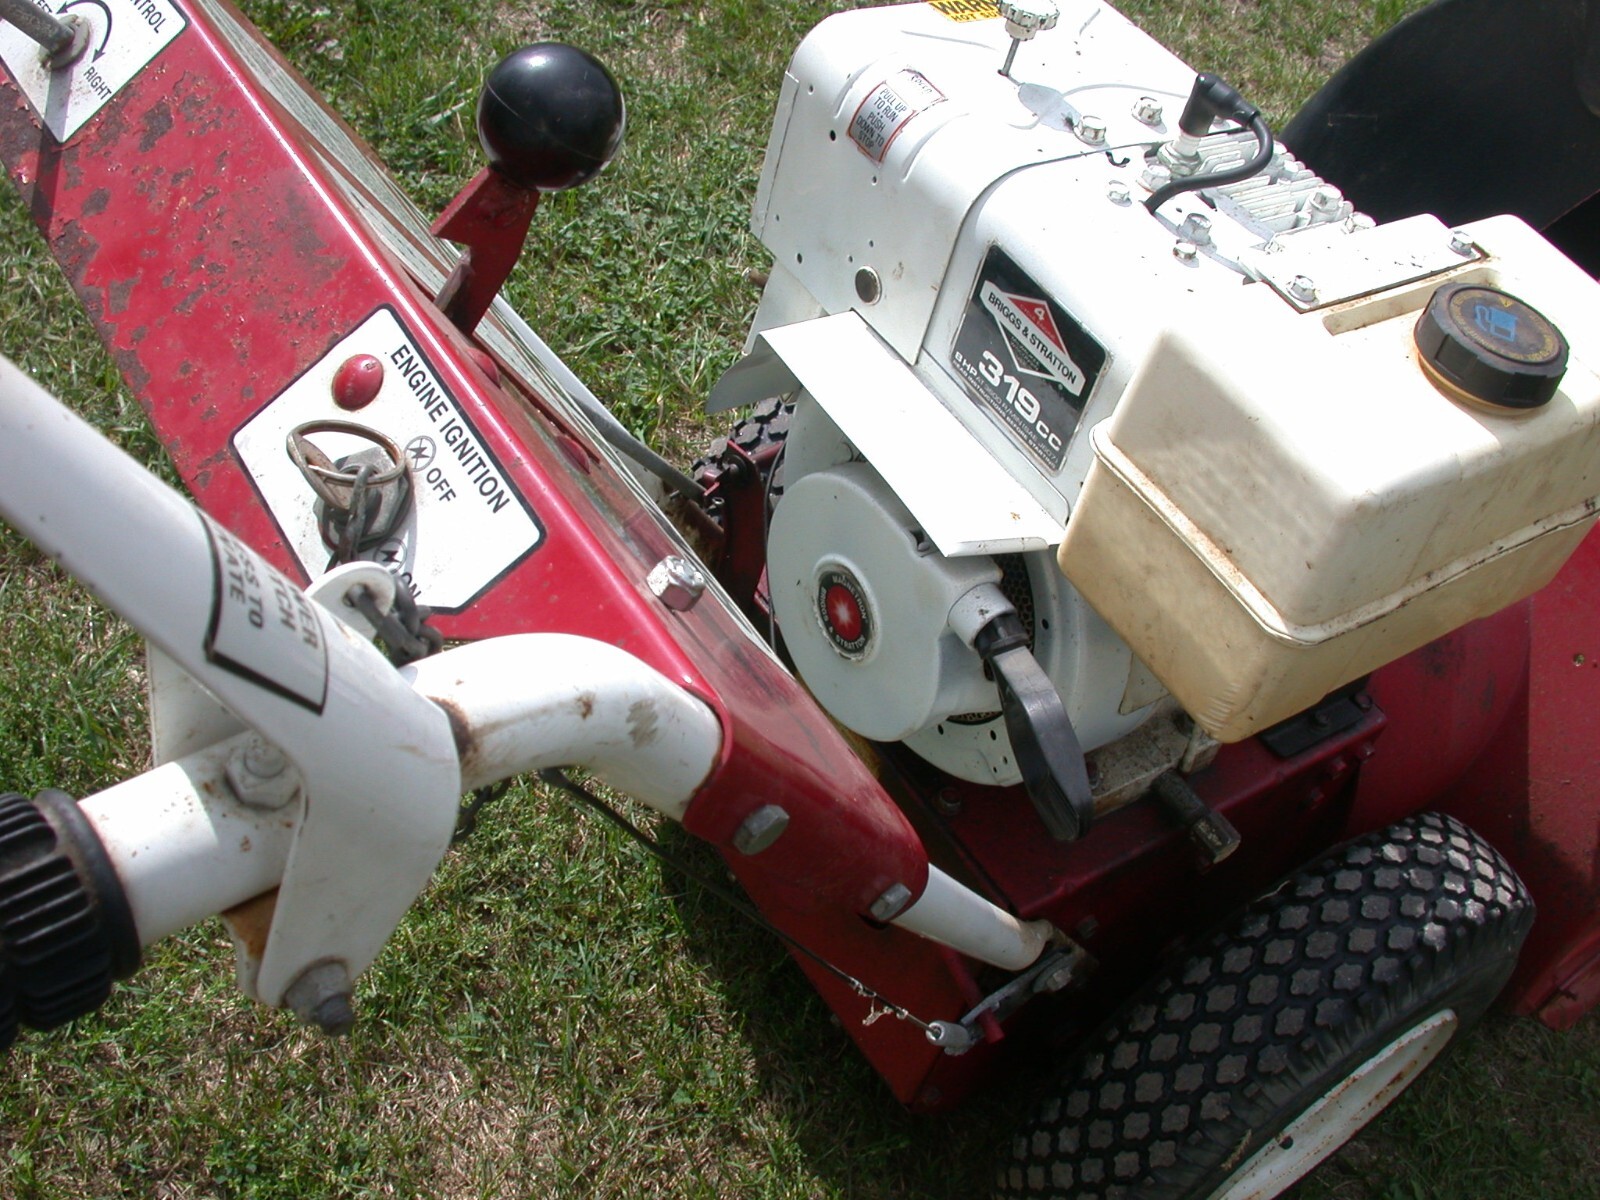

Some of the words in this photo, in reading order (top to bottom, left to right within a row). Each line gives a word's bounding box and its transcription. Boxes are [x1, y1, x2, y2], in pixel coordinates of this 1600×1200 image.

[950, 12, 976, 20] HOT
[83, 66, 113, 100] RIGHT
[873, 97, 884, 110] TO
[882, 105, 899, 123] RUN
[879, 88, 898, 106] PULL
[895, 101, 908, 113] UP
[856, 115, 876, 138] DOWN
[874, 134, 885, 147] TO
[867, 112, 887, 133] PUSH
[857, 131, 875, 148] STOP
[1033, 307, 1045, 320] 4
[988, 292, 1022, 330] BRIGGS
[1021, 325, 1030, 338] &
[1029, 332, 1077, 385] STRATTON
[390, 344, 449, 423] ENGINE
[439, 418, 510, 514] IGNITION
[425, 468, 457, 503] OFF
[247, 594, 263, 629] TO
[835, 633, 866, 649] STRATTON
